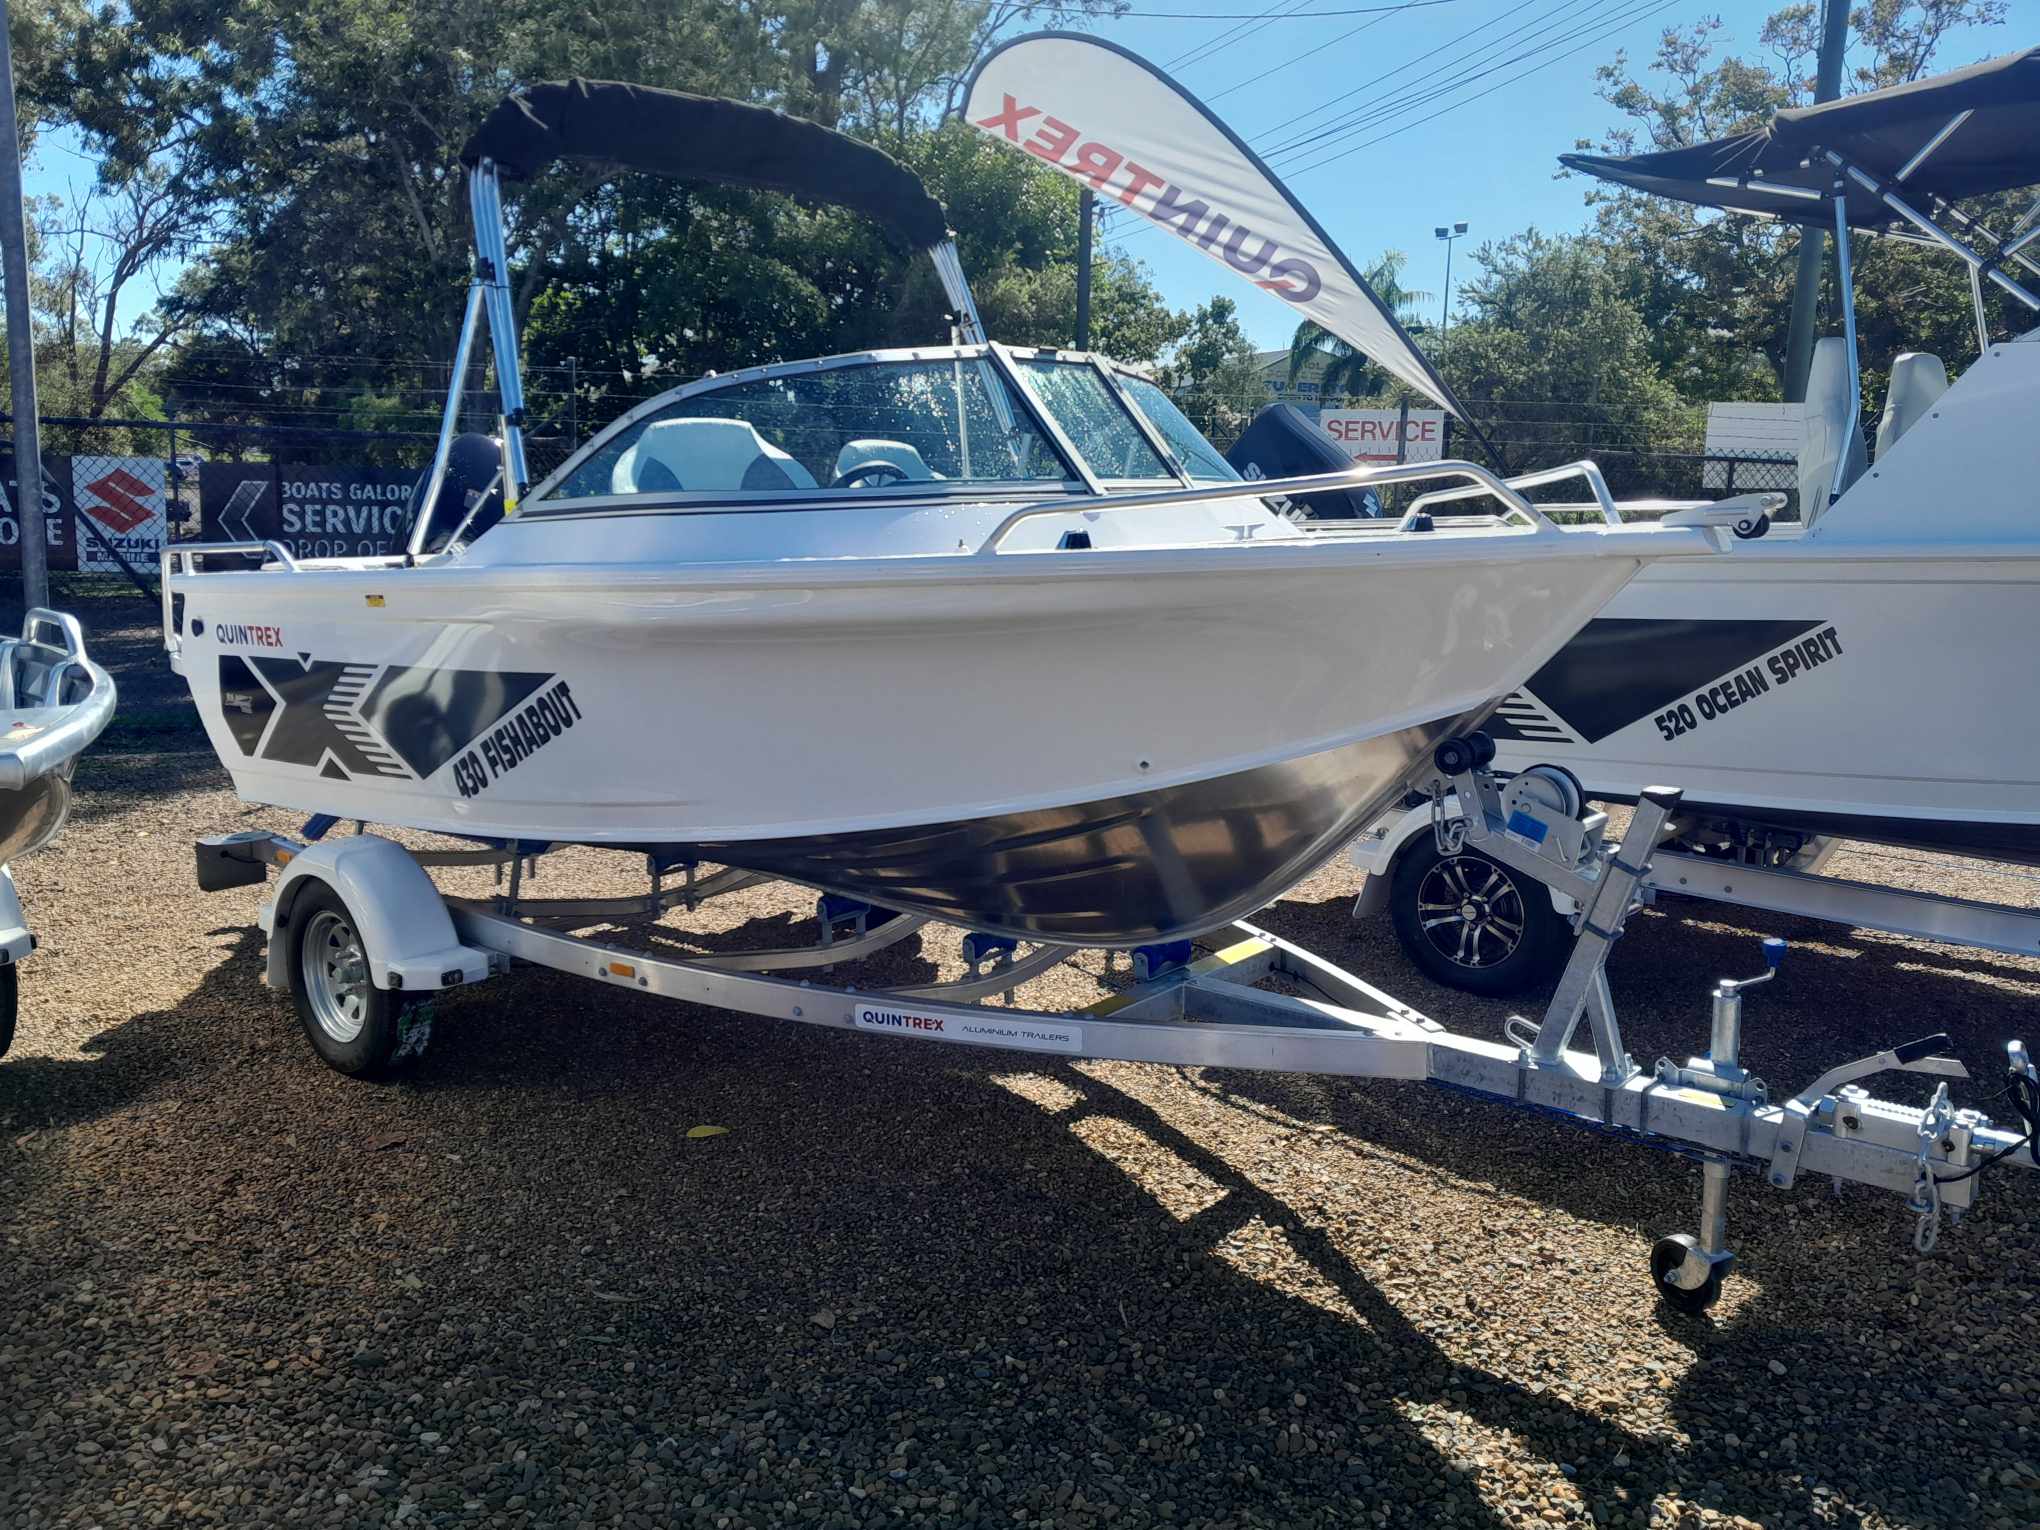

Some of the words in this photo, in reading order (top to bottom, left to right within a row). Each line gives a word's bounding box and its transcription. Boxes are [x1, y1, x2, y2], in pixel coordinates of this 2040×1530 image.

[1327, 420, 1437, 442] SERVICE
[281, 481, 342, 499] BOATS
[349, 483, 412, 500] GALOR
[282, 504, 402, 534] SERVIC
[86, 537, 160, 550] SZUKI
[216, 623, 283, 647] QUINTREX
[1654, 703, 1697, 741] 520
[1695, 665, 1770, 720] OCEAN
[1767, 626, 1843, 685] SPIRIT
[452, 750, 489, 799] 430
[480, 679, 582, 779] FISHABOUT
[863, 1011, 944, 1031] QUINTREX
[961, 1026, 1018, 1037] ALUMINIUM
[1021, 1031, 1070, 1042] TRAILERS
